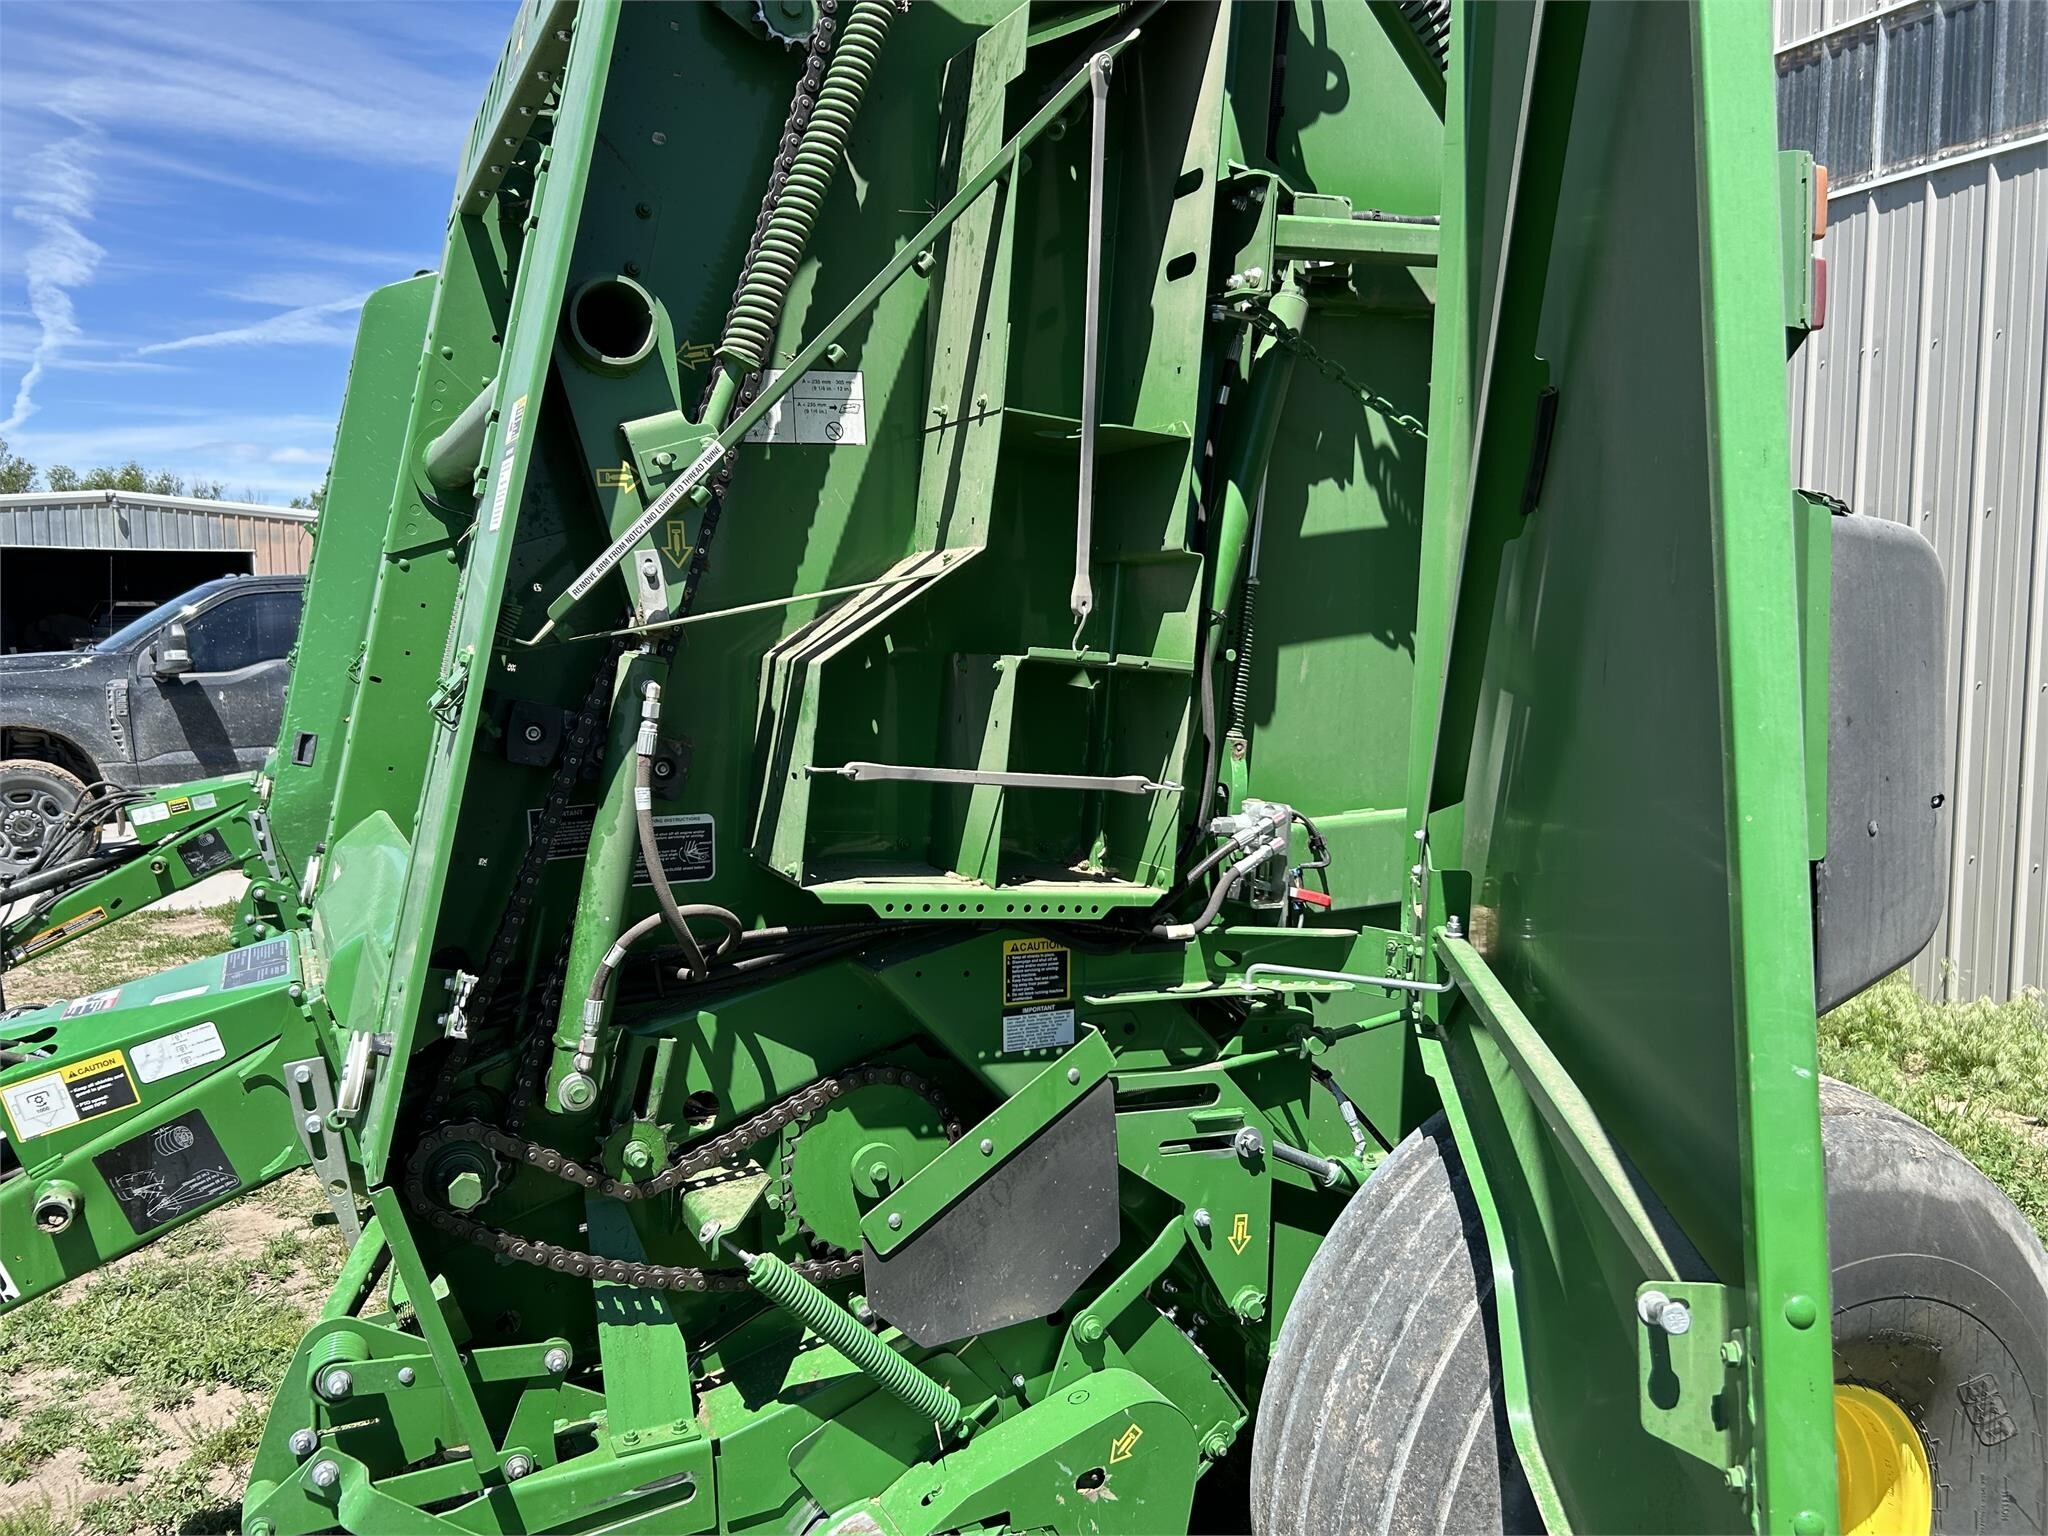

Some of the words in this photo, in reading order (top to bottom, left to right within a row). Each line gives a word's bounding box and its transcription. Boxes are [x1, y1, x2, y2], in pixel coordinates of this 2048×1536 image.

[572, 571, 598, 596] REMOVE
[595, 558, 611, 574] ARM
[609, 542, 626, 561] FROM
[625, 524, 646, 543] NOTCH
[643, 511, 657, 526] AND
[656, 492, 678, 514] LOWER
[674, 484, 685, 494] TO
[682, 464, 705, 486] THREAD
[702, 445, 722, 467] TWINE
[1022, 1004, 1056, 1013] IMPORTANT
[78, 1058, 116, 1075] CAUTION
